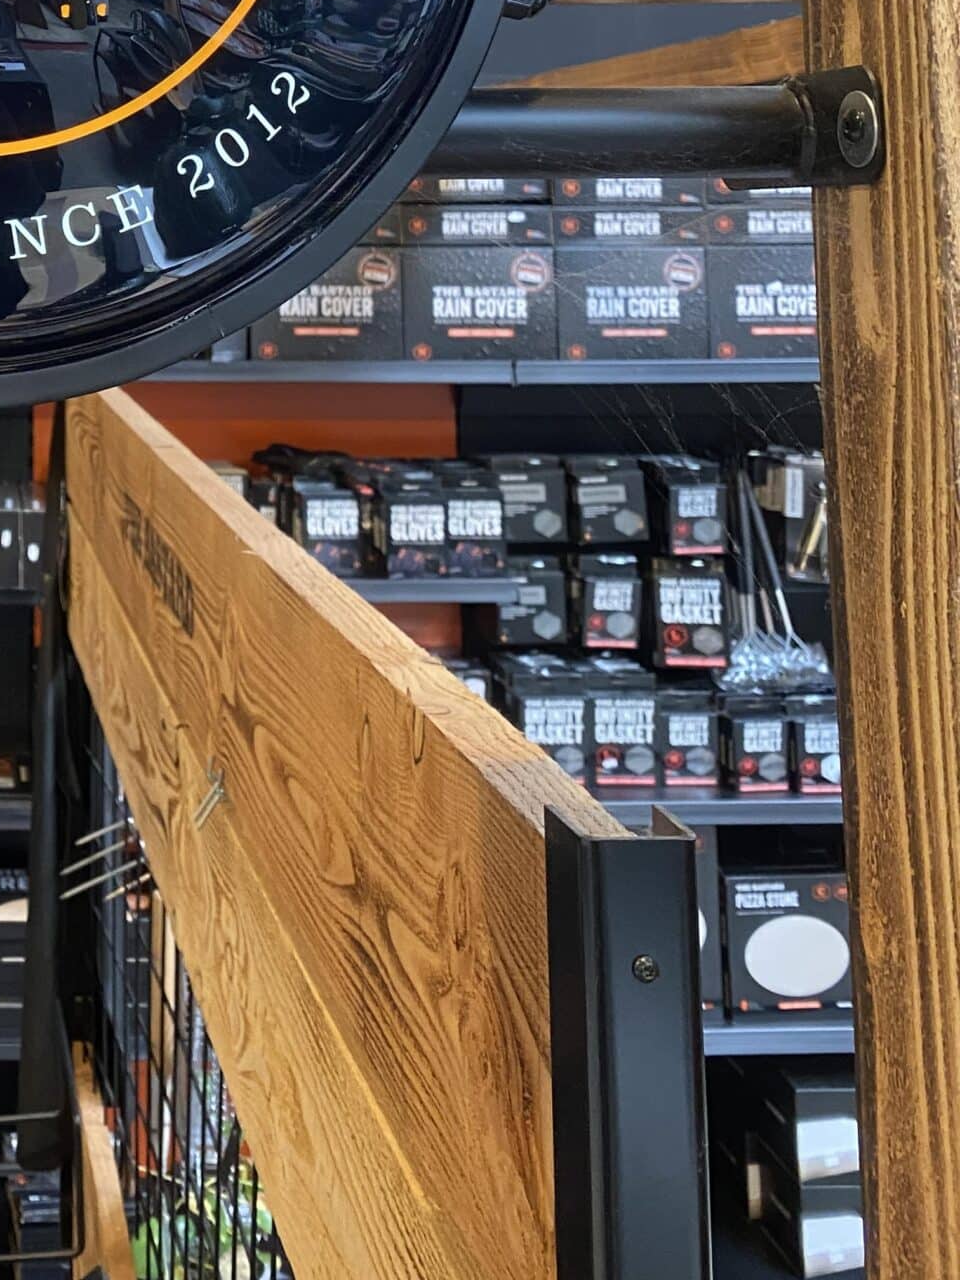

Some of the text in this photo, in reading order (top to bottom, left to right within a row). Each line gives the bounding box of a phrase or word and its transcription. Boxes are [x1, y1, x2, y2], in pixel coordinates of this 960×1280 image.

[176, 70, 311, 199] 2012
[279, 297, 374, 317] RAIN COVER
[432, 298, 528, 319] RAIN COVER
[586, 297, 681, 318] RAIN COVER
[736, 296, 817, 317] RAIN COVE
[660, 602, 723, 625] GASKET
[524, 707, 584, 724] INFINITY
[594, 707, 655, 724] INFINITY
[524, 723, 585, 745] GASKET
[594, 723, 655, 745] GASKET
